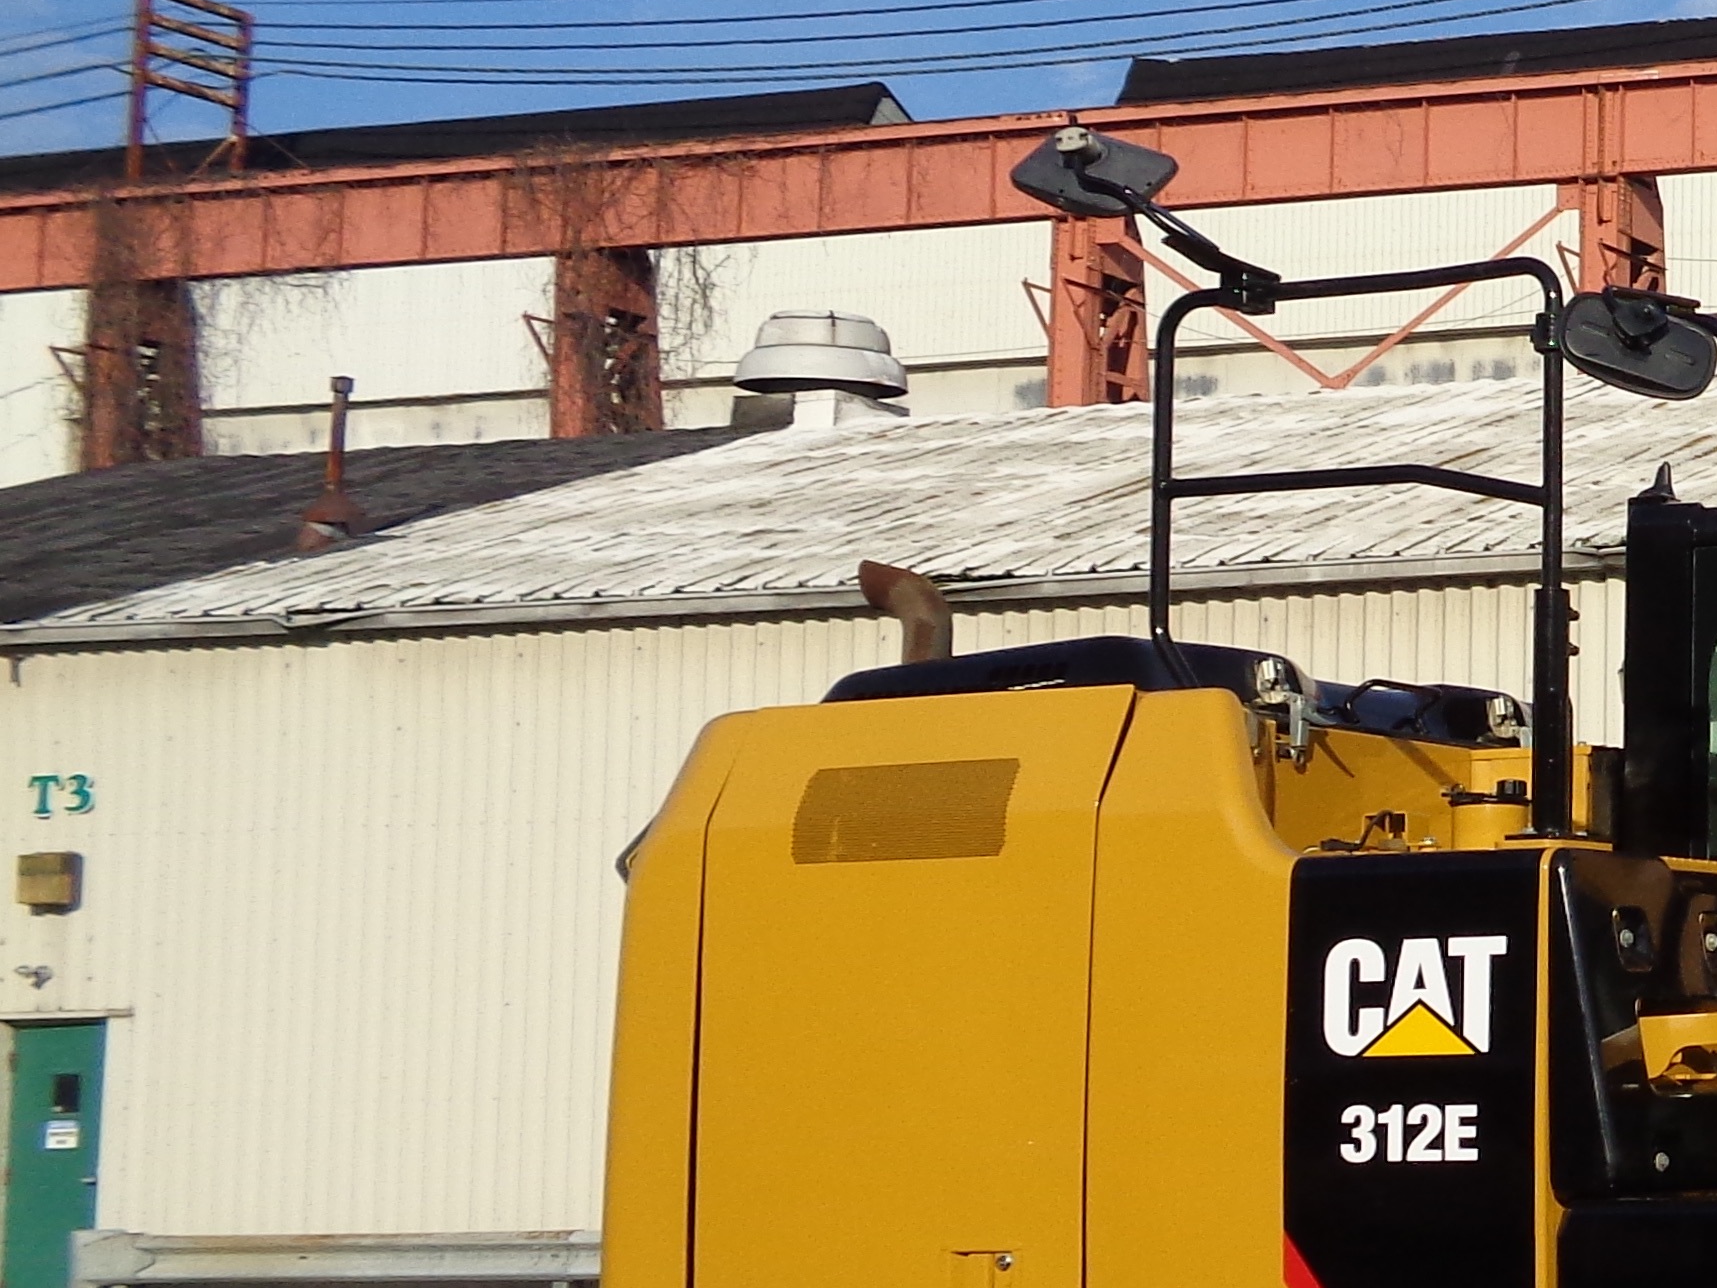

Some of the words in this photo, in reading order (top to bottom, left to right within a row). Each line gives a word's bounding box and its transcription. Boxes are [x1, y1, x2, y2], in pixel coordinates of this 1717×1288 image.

[28, 773, 92, 816] T3
[1323, 935, 1507, 1057] CAT
[1340, 1104, 1479, 1163] 312E
